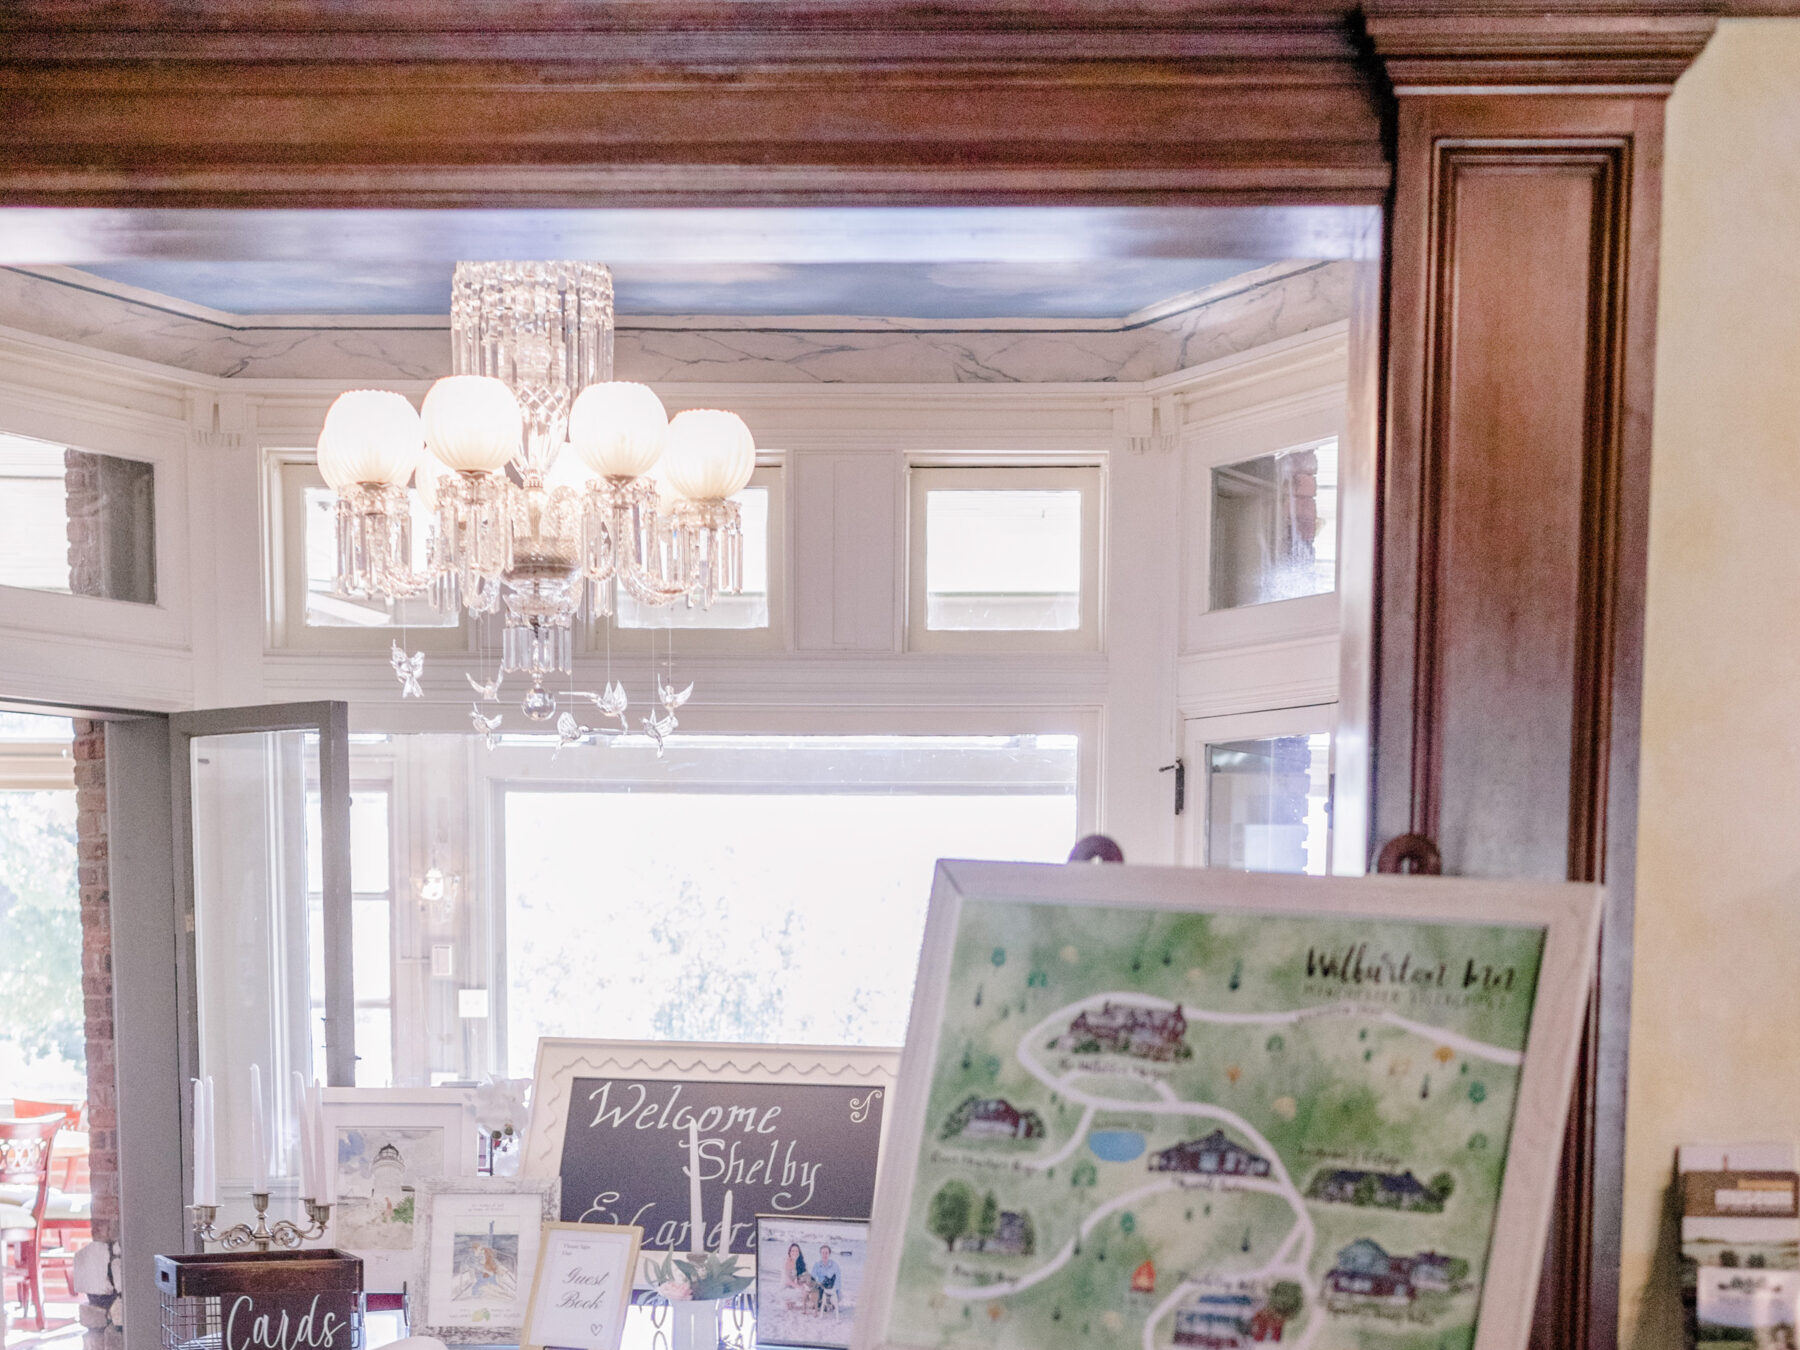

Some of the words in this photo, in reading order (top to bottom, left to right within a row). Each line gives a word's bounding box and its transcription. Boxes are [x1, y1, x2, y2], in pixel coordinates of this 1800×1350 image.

[588, 1081, 782, 1134] Welcome
[678, 1138, 822, 1211] Shelby
[562, 1267, 610, 1286] Guest
[556, 1290, 605, 1310] Book
